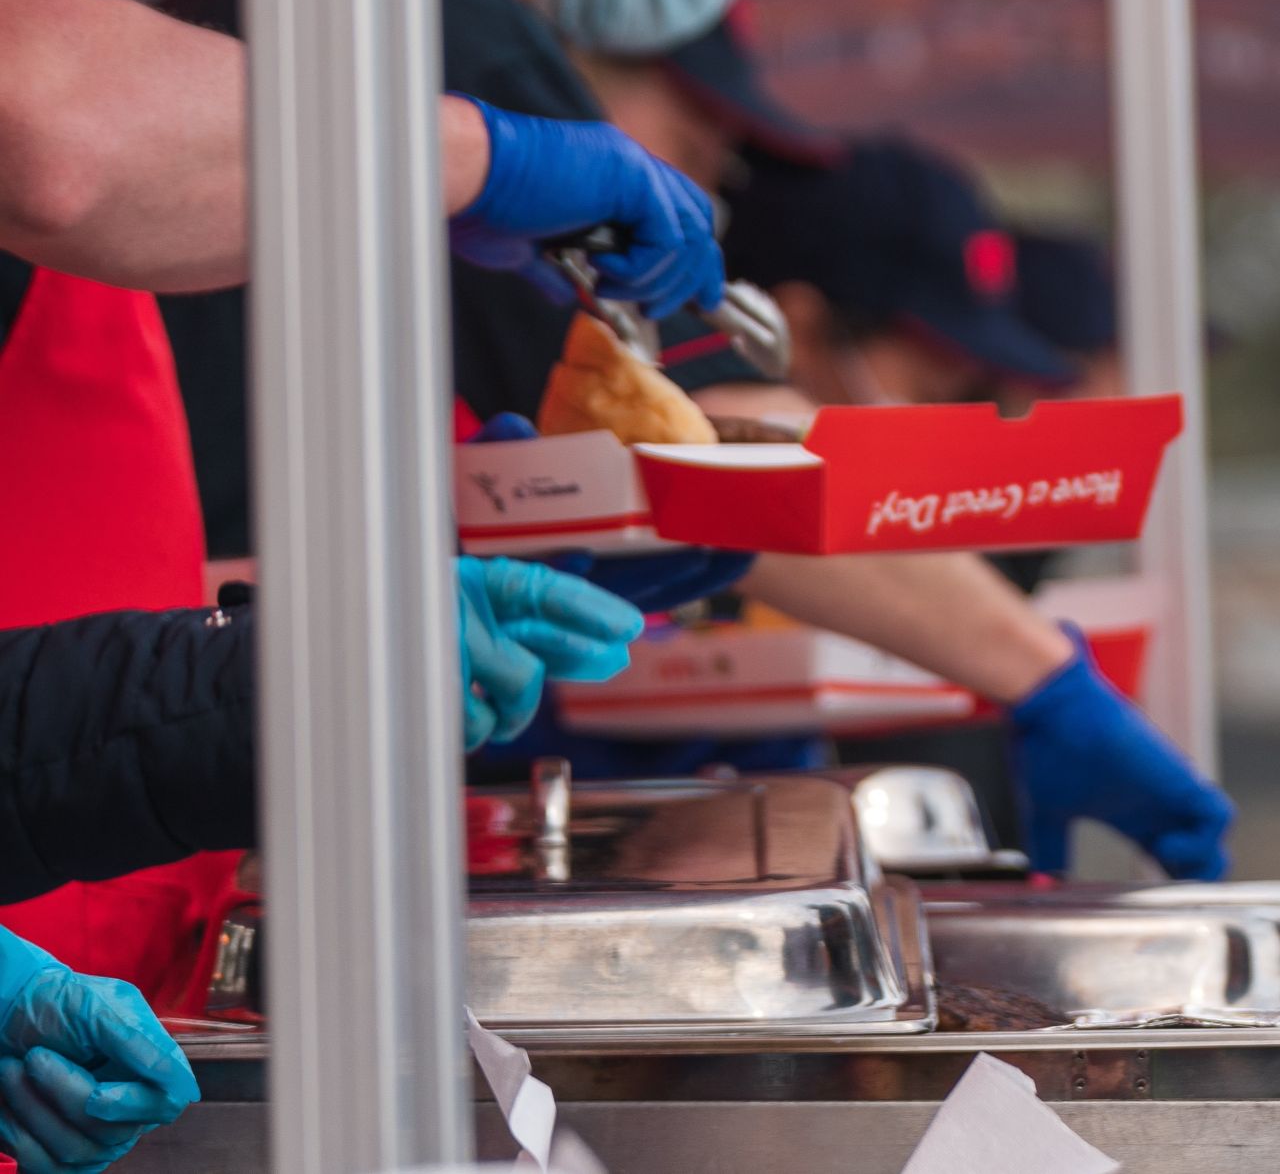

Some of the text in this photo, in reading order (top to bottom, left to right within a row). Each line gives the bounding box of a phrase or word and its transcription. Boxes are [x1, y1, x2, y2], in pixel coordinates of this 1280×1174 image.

[942, 483, 1024, 524] Great
[1028, 479, 1050, 506] a
[1050, 470, 1122, 508] Have
